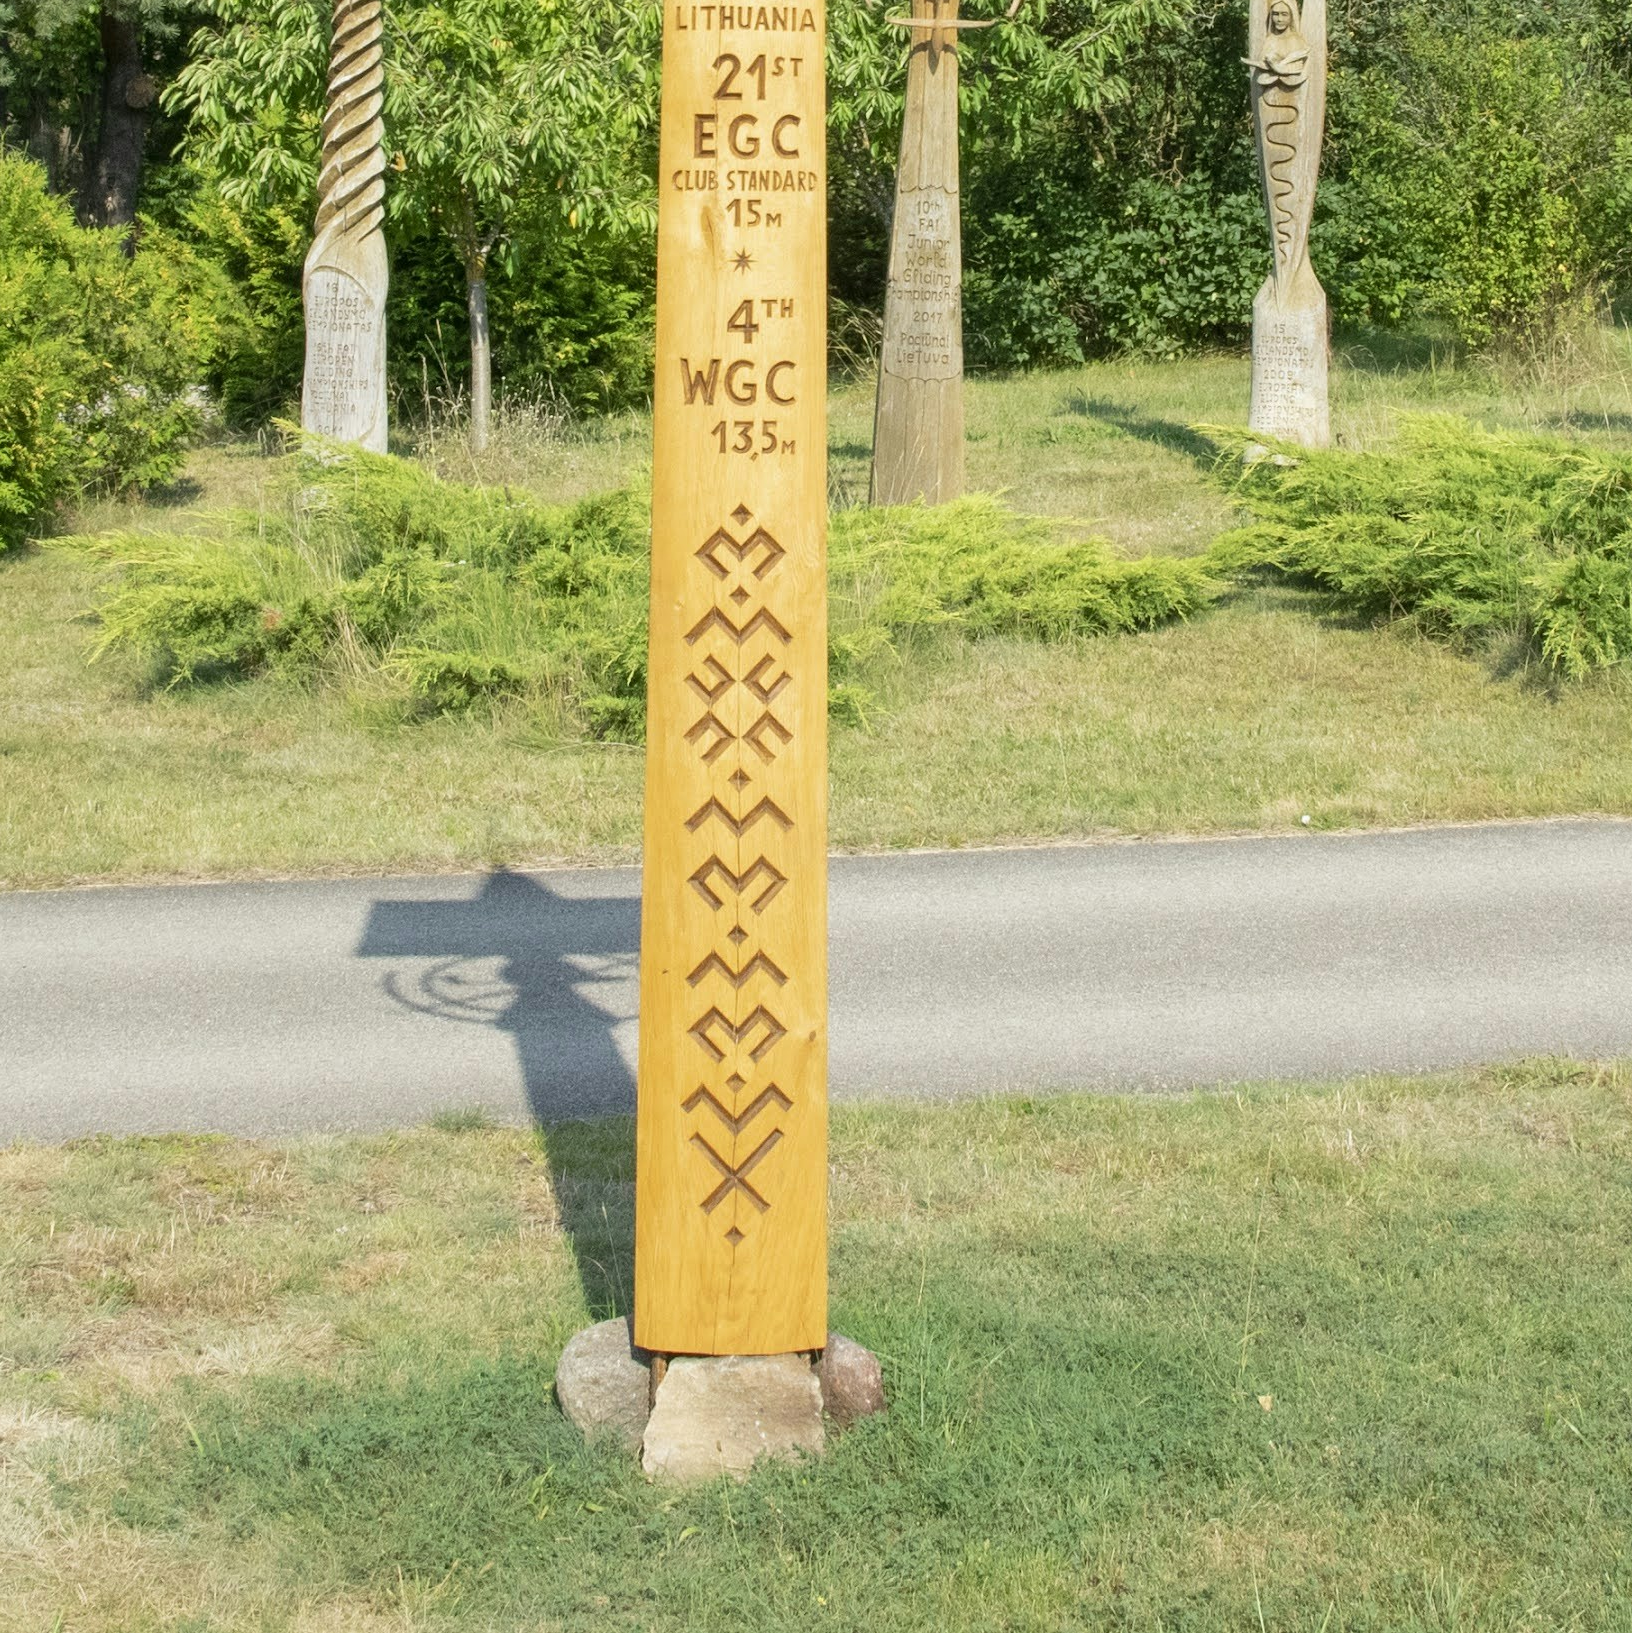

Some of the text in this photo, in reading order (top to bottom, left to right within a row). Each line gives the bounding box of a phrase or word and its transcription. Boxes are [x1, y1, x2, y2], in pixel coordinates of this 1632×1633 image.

[675, 5, 817, 32] LITHUANIA
[693, 113, 801, 160] EGC
[672, 169, 817, 192] CLUB STANDARD
[919, 218, 940, 232] FAI
[907, 234, 950, 249] Junior
[903, 268, 951, 288] Gliding
[913, 311, 943, 323] 2017
[680, 358, 797, 407] WGC
